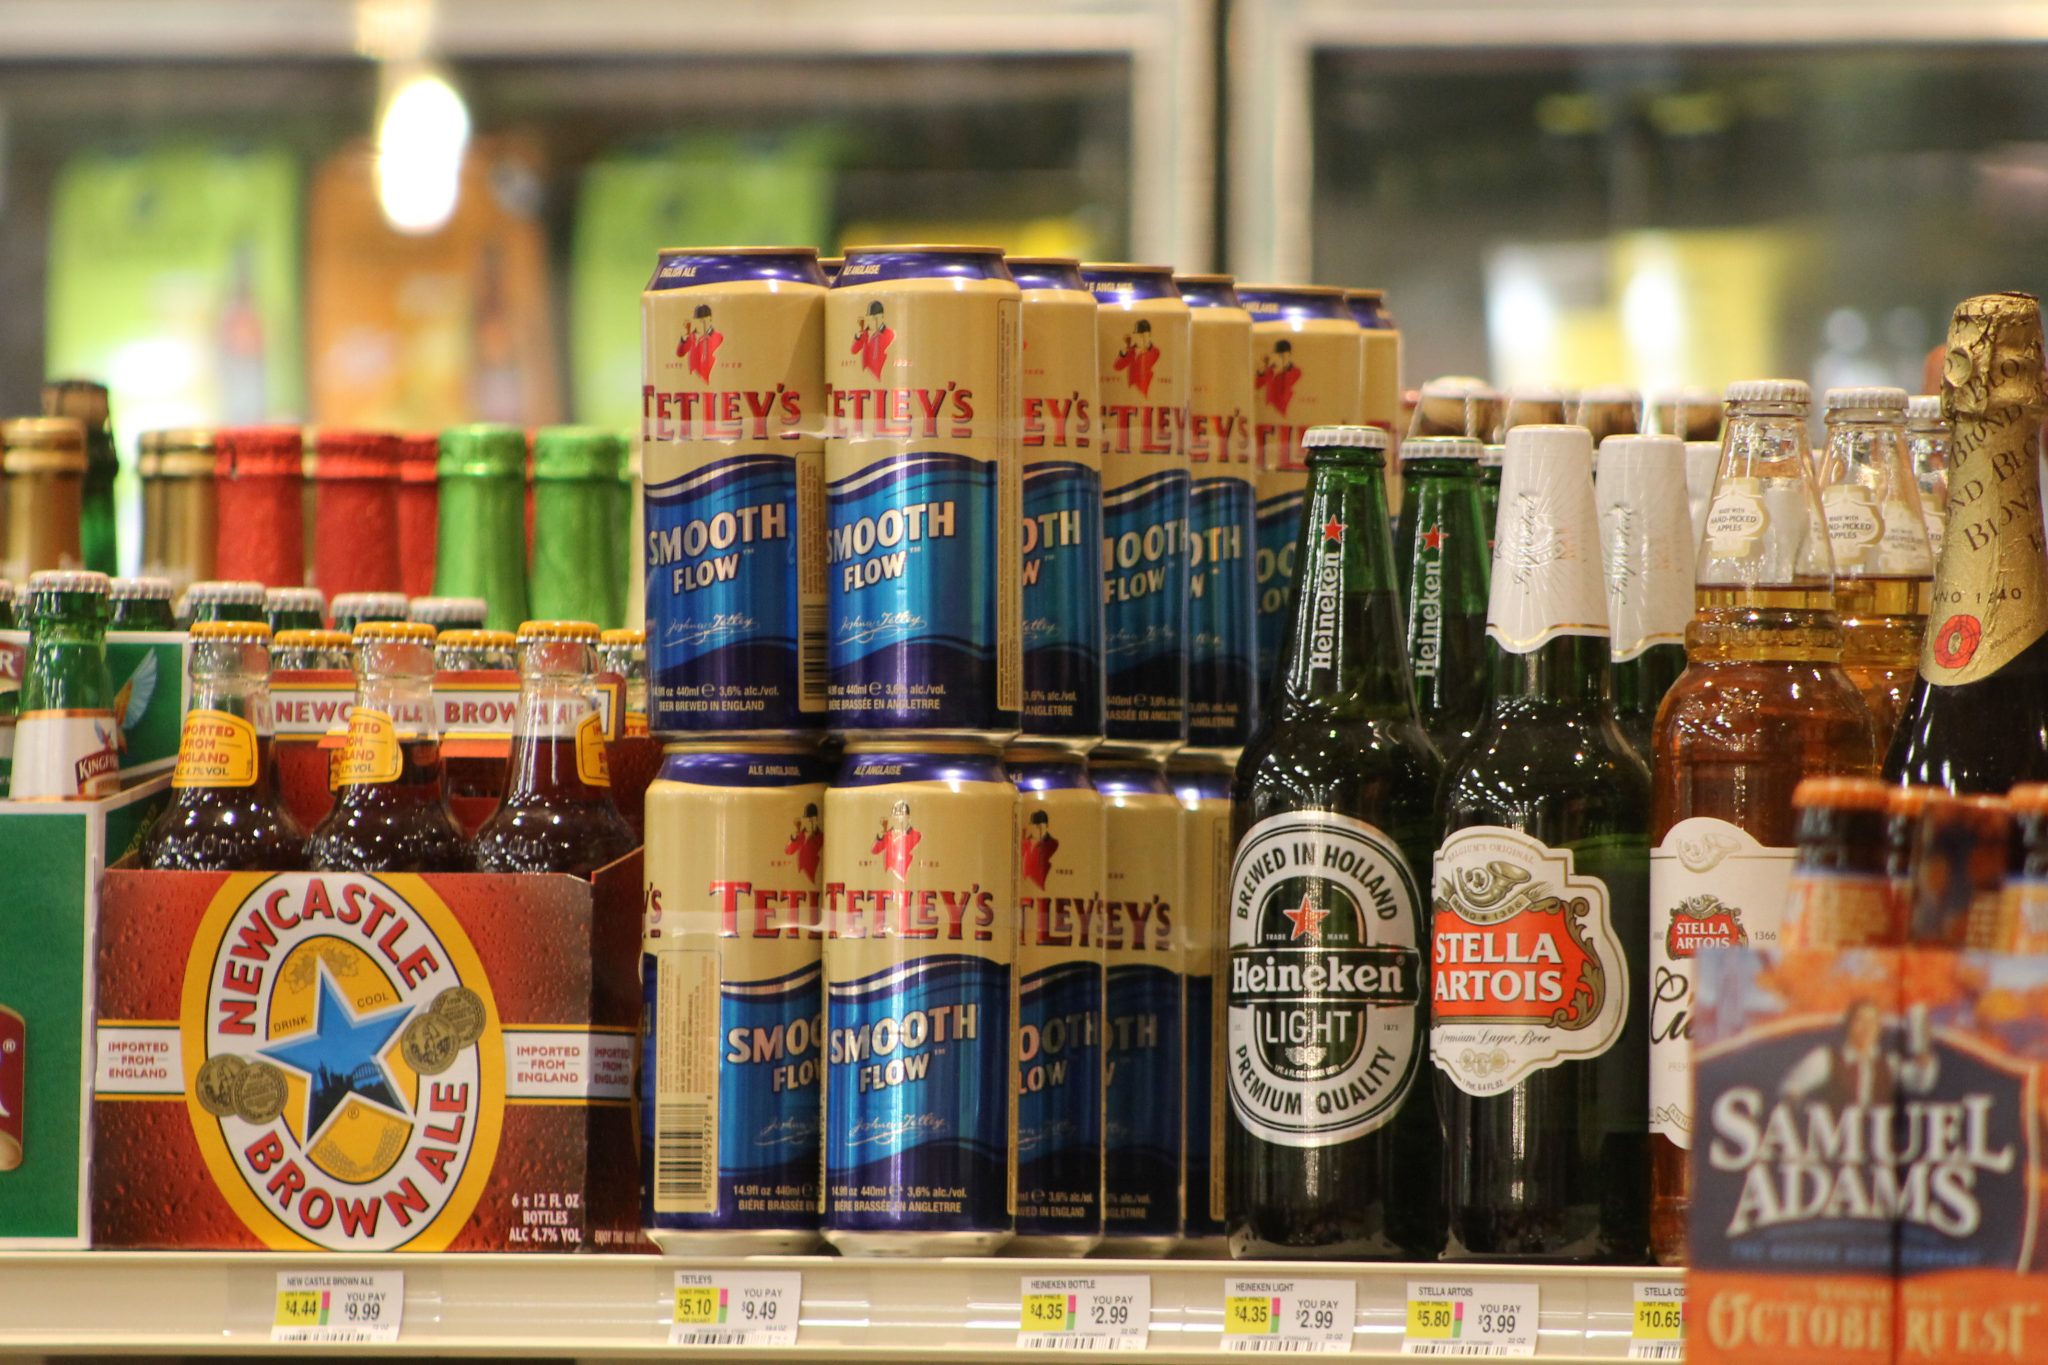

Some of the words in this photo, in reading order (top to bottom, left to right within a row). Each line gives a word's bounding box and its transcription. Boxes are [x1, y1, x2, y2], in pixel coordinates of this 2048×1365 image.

[647, 501, 787, 567] SMOOTH
[672, 551, 740, 597] FLOW
[843, 550, 907, 594] FLOW
[1311, 550, 1340, 670] Heineken
[1415, 560, 1442, 678] Heineken
[721, 699, 765, 711] ENGLAND
[183, 725, 235, 738] PORTED
[179, 752, 230, 764] NGLAND
[1236, 847, 1287, 921] BREWED
[1292, 842, 1316, 866] IN
[1322, 844, 1398, 921] HOLLAND
[825, 881, 995, 940] TETLEY'S
[1676, 921, 1730, 936] STELLA
[1754, 930, 1777, 941] 1366
[1435, 931, 1563, 965] STELLA
[217, 878, 441, 1037] NEWCASTLE
[1232, 954, 1405, 994] Heineken
[1434, 969, 1565, 1003] ARTOIS
[356, 991, 390, 1008] COOL
[272, 1015, 309, 1034] DRINK
[1265, 1009, 1353, 1044] LIGHT
[830, 1003, 978, 1065] SMOOTH
[1479, 1028, 1516, 1046] Lager
[1519, 1028, 1552, 1046] Beer
[107, 1041, 169, 1054] IMPORTED
[516, 1046, 581, 1058] IMPORTED
[121, 1055, 156, 1066] FROM
[530, 1059, 566, 1070] FROM
[107, 1068, 168, 1080] ENGLAND
[517, 1072, 579, 1084] ENGLAND
[859, 1053, 930, 1094] FLOW
[1235, 1043, 1303, 1116] PREMIUM
[1315, 1045, 1397, 1115] QUALITY
[1708, 1086, 2017, 1173] SAMUEL
[244, 1130, 430, 1238] BROWN
[415, 1081, 469, 1184] ALE
[511, 1193, 519, 1208] 6
[532, 1193, 546, 1208] 12
[550, 1193, 562, 1208] FL
[564, 1193, 580, 1208] OZ
[1725, 1161, 1982, 1239] ADAMS
[522, 1210, 568, 1225] BOTTLES
[508, 1227, 529, 1242] ALC
[531, 1227, 558, 1243] 4.7%
[560, 1227, 582, 1242] VOL
[287, 1276, 303, 1286] NEW
[304, 1276, 331, 1286] CASTLE
[332, 1276, 359, 1286] BROWN
[360, 1276, 374, 1286] ALE
[680, 1274, 713, 1285] TETLEYS
[1030, 1279, 1067, 1290] HEINEKEN
[1067, 1279, 1096, 1290] BOTTLE
[1235, 1282, 1272, 1292] HEINEKEN
[1272, 1282, 1295, 1293] LIGHT
[346, 1292, 365, 1302] YOU
[367, 1292, 386, 1302] PAY
[743, 1288, 763, 1298] YOU
[764, 1288, 783, 1298] PAY
[1092, 1295, 1113, 1305] YOU
[1115, 1295, 1134, 1305] PAY
[1418, 1286, 1446, 1297] STELLA
[1446, 1287, 1474, 1297] ARTOIS
[1643, 1286, 1672, 1297] STELLA
[1673, 1287, 1687, 1297] CID
[286, 1299, 317, 1317] $4.44
[344, 1301, 381, 1321] $9.99
[679, 1298, 712, 1316] $5.10
[741, 1300, 777, 1320] $9.49
[1030, 1303, 1063, 1320] $4.35
[1297, 1299, 1318, 1310] YOU
[1319, 1300, 1340, 1310] PAY
[1480, 1303, 1500, 1314] YOU
[1502, 1304, 1522, 1314] PAY
[1091, 1305, 1128, 1325] $2.99
[1235, 1305, 1268, 1323] $4.35
[1295, 1309, 1334, 1329] $2.99
[1417, 1310, 1451, 1328] $5.80
[1639, 1310, 1681, 1329] $10.65
[1478, 1314, 1516, 1334] $3.99
